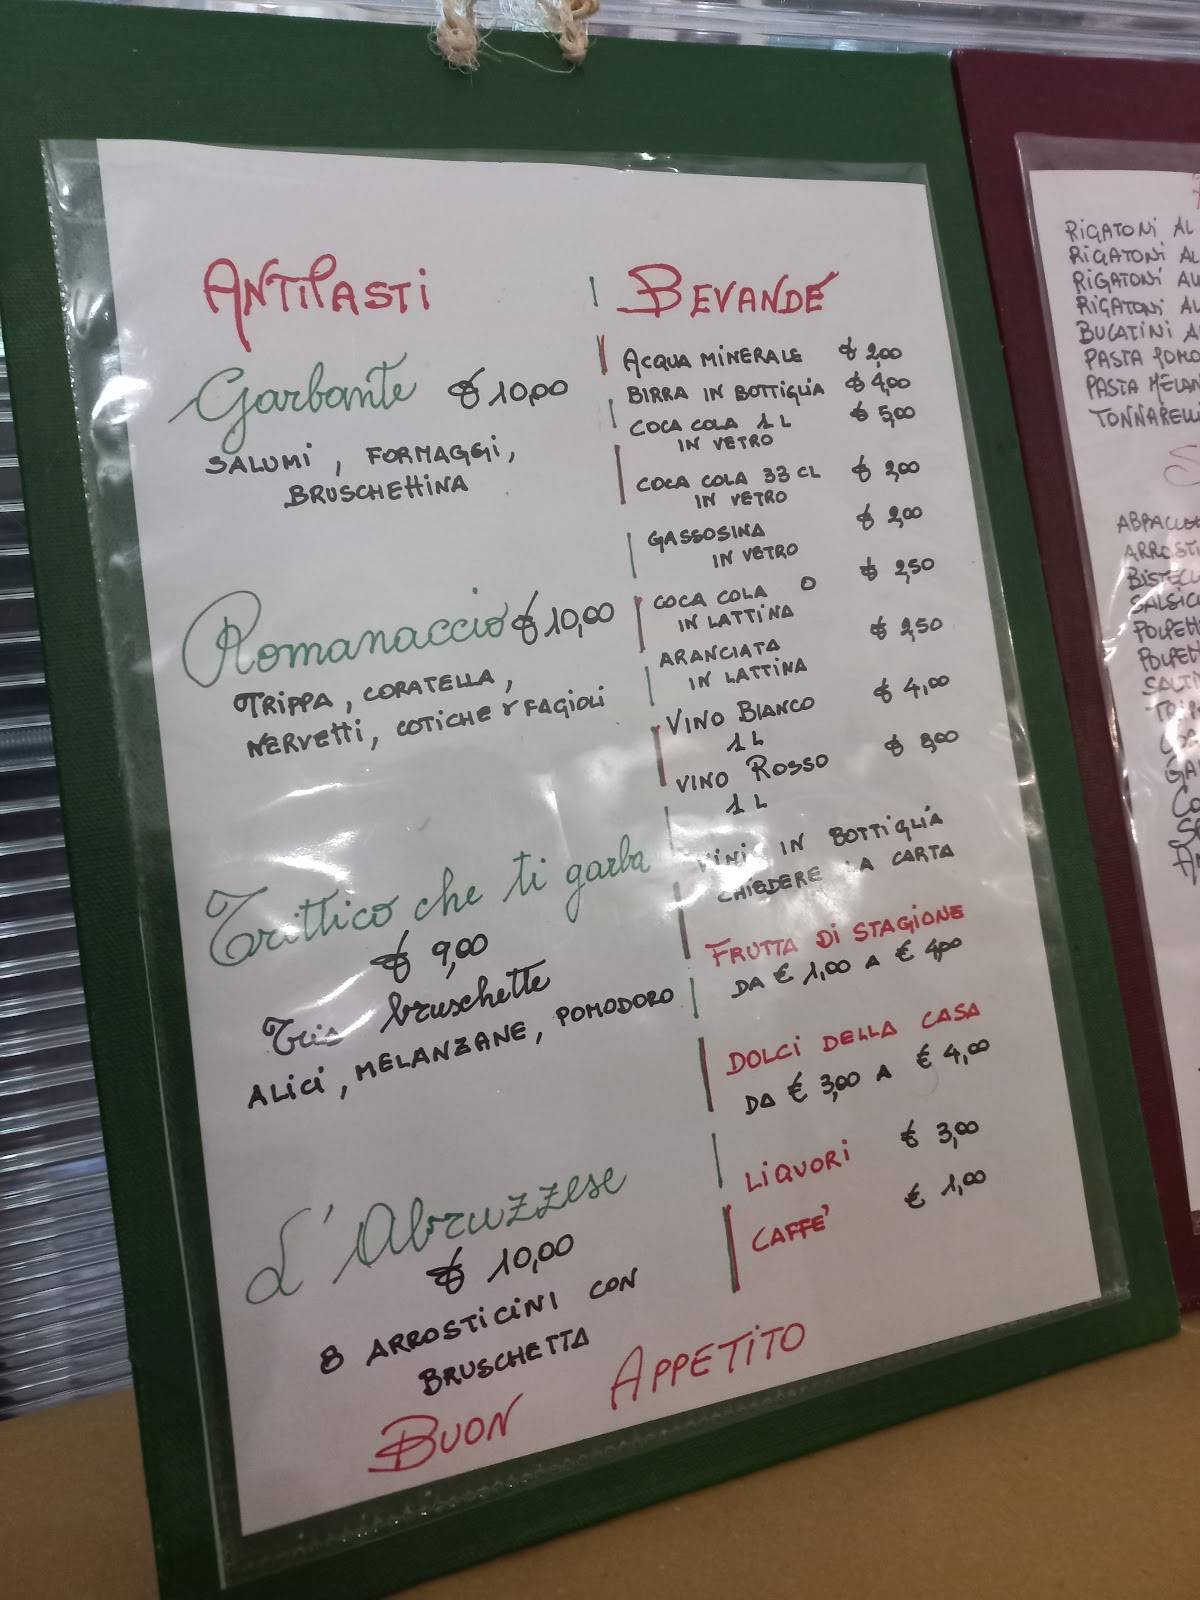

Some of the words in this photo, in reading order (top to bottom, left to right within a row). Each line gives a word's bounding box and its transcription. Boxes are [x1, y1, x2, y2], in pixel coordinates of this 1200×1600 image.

[1064, 217, 1157, 243] RIGATONI
[1069, 241, 1165, 266] RIGATONI
[617, 263, 839, 318] BEVANDE
[1072, 267, 1162, 294] RIGATONI
[204, 254, 430, 351] ANTIPASTI
[1076, 295, 1164, 318] RIGATONI
[1075, 320, 1173, 345] BUCATINI
[622, 348, 692, 378] ACQUA
[700, 345, 803, 367] MINERALE
[866, 343, 903, 368] 2,00
[1084, 348, 1144, 370] PASTA
[489, 380, 568, 406] 10,00
[627, 386, 689, 404] BIRRA
[703, 384, 723, 402] IN
[735, 378, 825, 406] BOTTIGLIA
[871, 372, 911, 396] 4,00
[1086, 374, 1139, 400] PASTA
[629, 418, 683, 437] COCA
[691, 417, 739, 432] COLA
[757, 413, 774, 429] 1
[780, 415, 792, 428] L
[878, 405, 916, 428] 5,00
[677, 438, 700, 452] IN
[713, 434, 773, 450] VETRO
[284, 475, 469, 508] BRUSCHETTINA
[636, 475, 690, 492] COCA
[701, 472, 748, 489] COLA
[763, 465, 790, 483] 33
[797, 466, 822, 479] CL
[694, 493, 716, 509] IN
[731, 490, 788, 507] VETRO
[648, 523, 766, 553] GASSOSINA
[888, 505, 923, 528] 2,00
[713, 553, 733, 569] IN
[742, 542, 799, 561] VETRO
[654, 592, 707, 610] COCA
[716, 584, 768, 605] COLA
[800, 575, 816, 591] O
[895, 557, 935, 584] 2,50
[182, 586, 508, 688] Romanaccio
[545, 602, 615, 639] 10,00
[678, 614, 698, 632] IN
[707, 603, 794, 629] LATTINA
[659, 638, 781, 668] ARANCIATA
[900, 617, 943, 642] 2,50
[689, 670, 711, 690] IN
[725, 657, 807, 685] LATTINA
[396, 704, 492, 738] COTICHE
[524, 685, 606, 719] FAGIOLI
[666, 708, 725, 735] VINO
[736, 697, 815, 722] BIANCO
[903, 674, 950, 699] 4,00
[726, 732, 746, 753] 1
[751, 731, 764, 746] L
[676, 772, 729, 793] VINO
[745, 754, 829, 782] ROSSO
[726, 793, 744, 815] 1
[755, 794, 767, 810] L
[780, 833, 804, 855] IN
[829, 805, 944, 846] BOTTIGLIA
[414, 867, 483, 921] che
[502, 850, 548, 903] ti
[566, 835, 651, 922] garba
[717, 866, 822, 903] CHIEDERE
[846, 856, 874, 873] A
[892, 843, 955, 866] CARTA
[704, 938, 799, 967] FRUTTA
[816, 923, 841, 949] DI
[853, 904, 964, 942] STAGIONE
[431, 933, 488, 980] 9,00
[731, 976, 765, 998] DA
[773, 962, 795, 984] €
[803, 960, 851, 985] 1,00
[865, 955, 880, 970] A
[895, 939, 914, 962] €
[925, 937, 962, 963] 4,00
[380, 959, 550, 1034] bruschette
[556, 987, 675, 1026] POMODORO
[726, 1035, 801, 1076] DOLCI
[823, 1020, 898, 1053] DELLA
[921, 1002, 981, 1030] CASA
[744, 1092, 776, 1115] DA
[787, 1071, 808, 1104] €
[820, 1071, 860, 1103] 3,00
[876, 1064, 892, 1082] A
[916, 1043, 932, 1069] €
[943, 1039, 990, 1065] 4,00
[745, 1139, 850, 1193] LIQUORI
[900, 1119, 919, 1148] €
[936, 1120, 980, 1150] 3,00
[904, 1183, 925, 1209] €
[941, 1169, 986, 1197] 1,00
[487, 1233, 575, 1284] 10,00
[319, 1345, 345, 1374] 8
[366, 1291, 558, 1367] ARROSTICINI
[589, 1268, 638, 1299] CON
[418, 1326, 590, 1396] BRUSCHETTA
[367, 1393, 524, 1473] BUON
[611, 1323, 806, 1412] APPETITO
